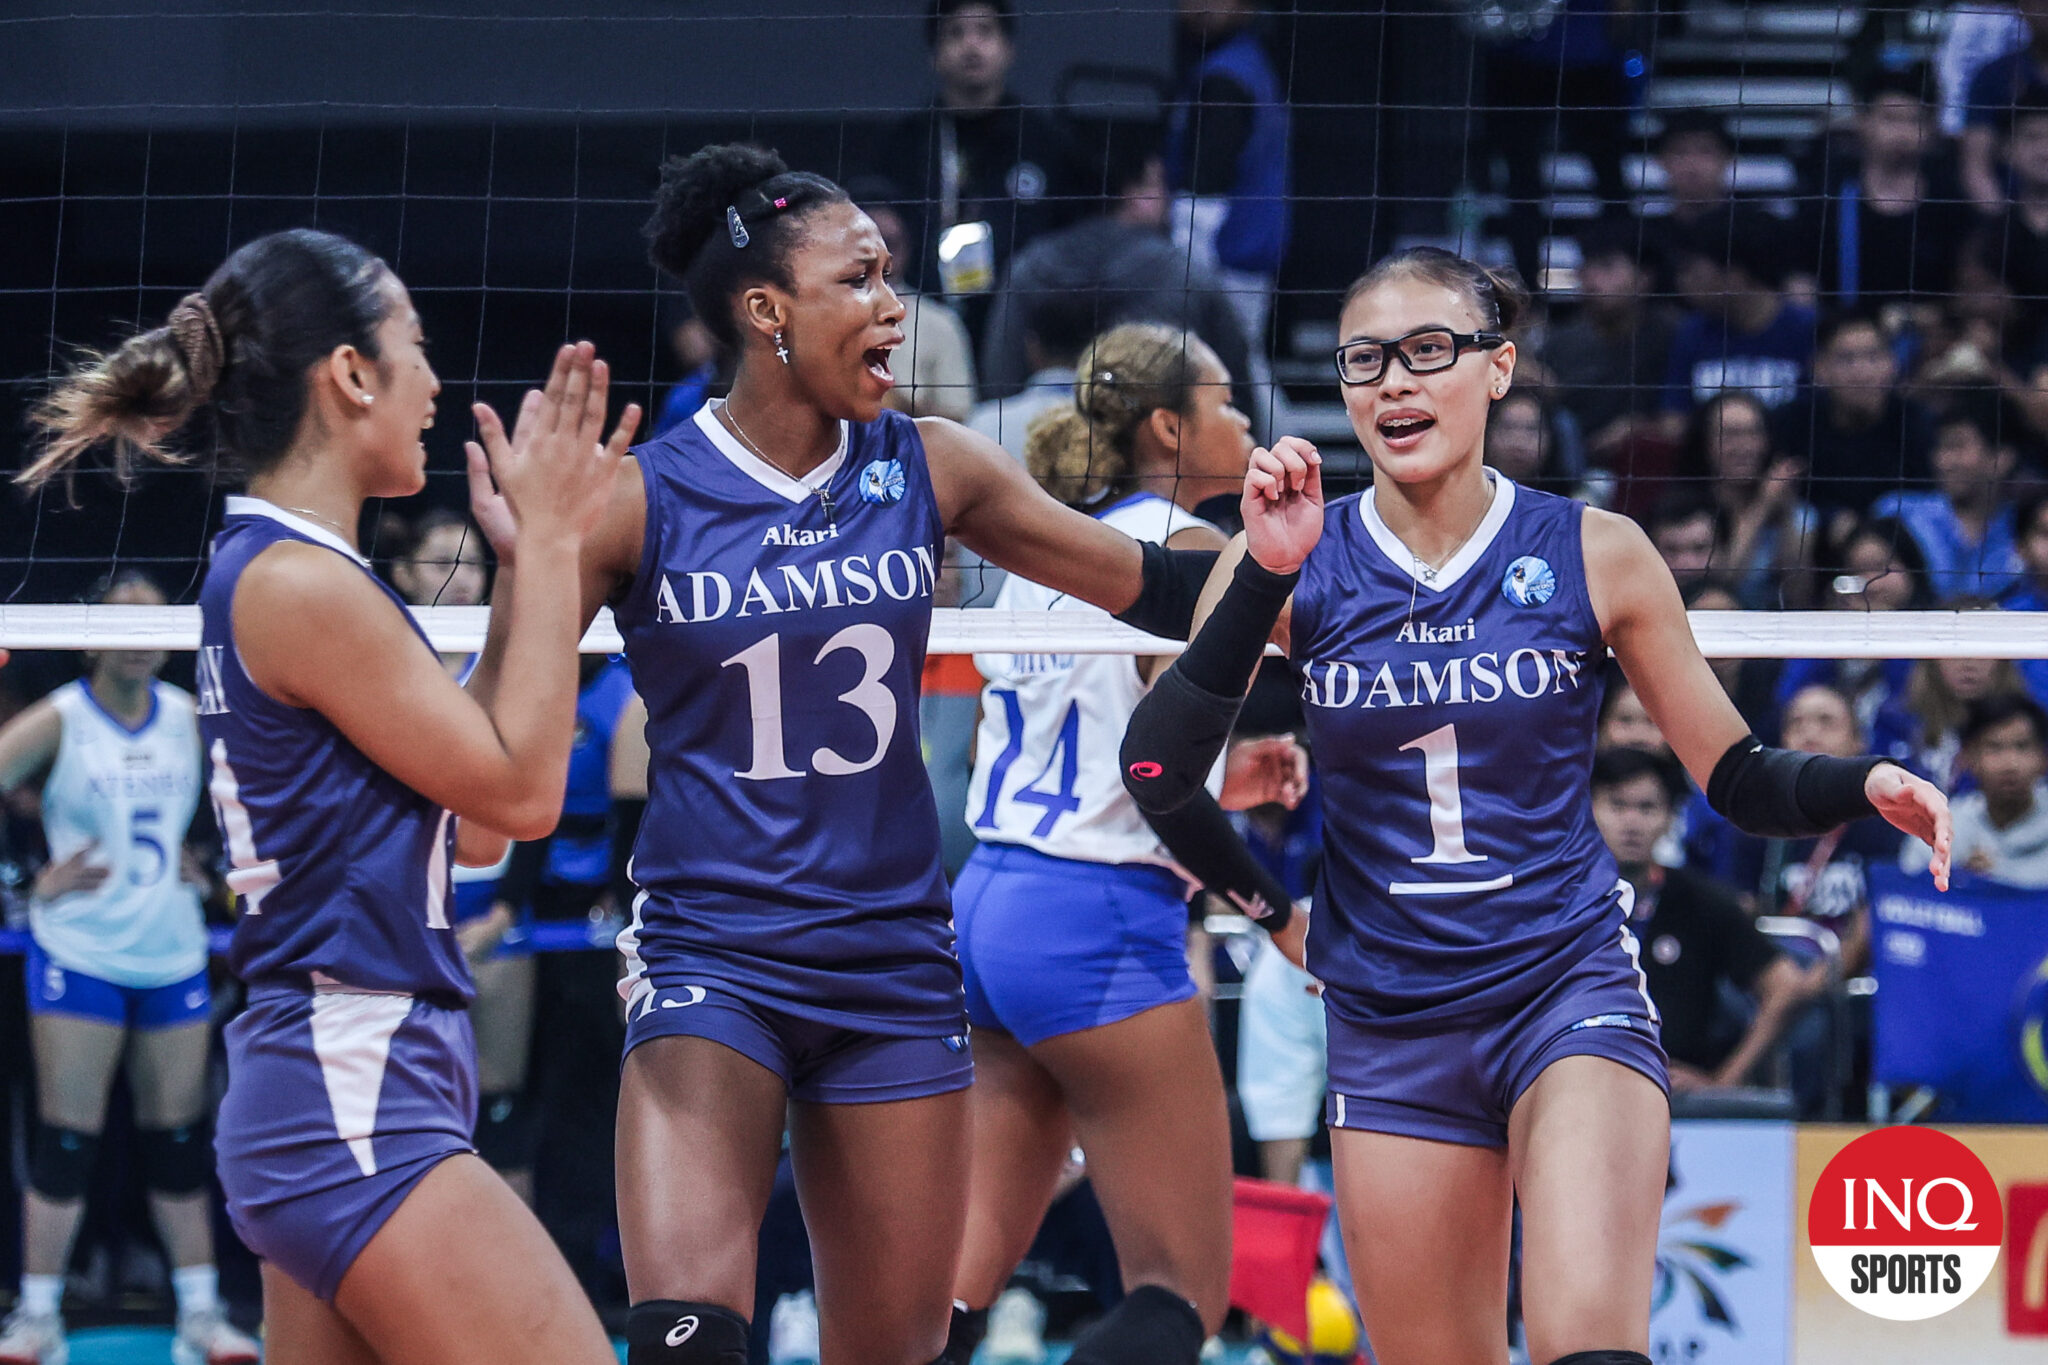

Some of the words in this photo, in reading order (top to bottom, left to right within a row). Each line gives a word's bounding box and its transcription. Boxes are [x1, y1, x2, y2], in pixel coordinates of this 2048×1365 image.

[761, 523, 839, 547] Akari
[656, 544, 935, 624] ADAMSON
[1395, 618, 1476, 643] Akari
[720, 622, 898, 780] 13
[1301, 648, 1586, 709] ADAMSON
[975, 690, 1081, 838] 14
[1399, 723, 1489, 864] 1
[131, 808, 168, 887] 5
